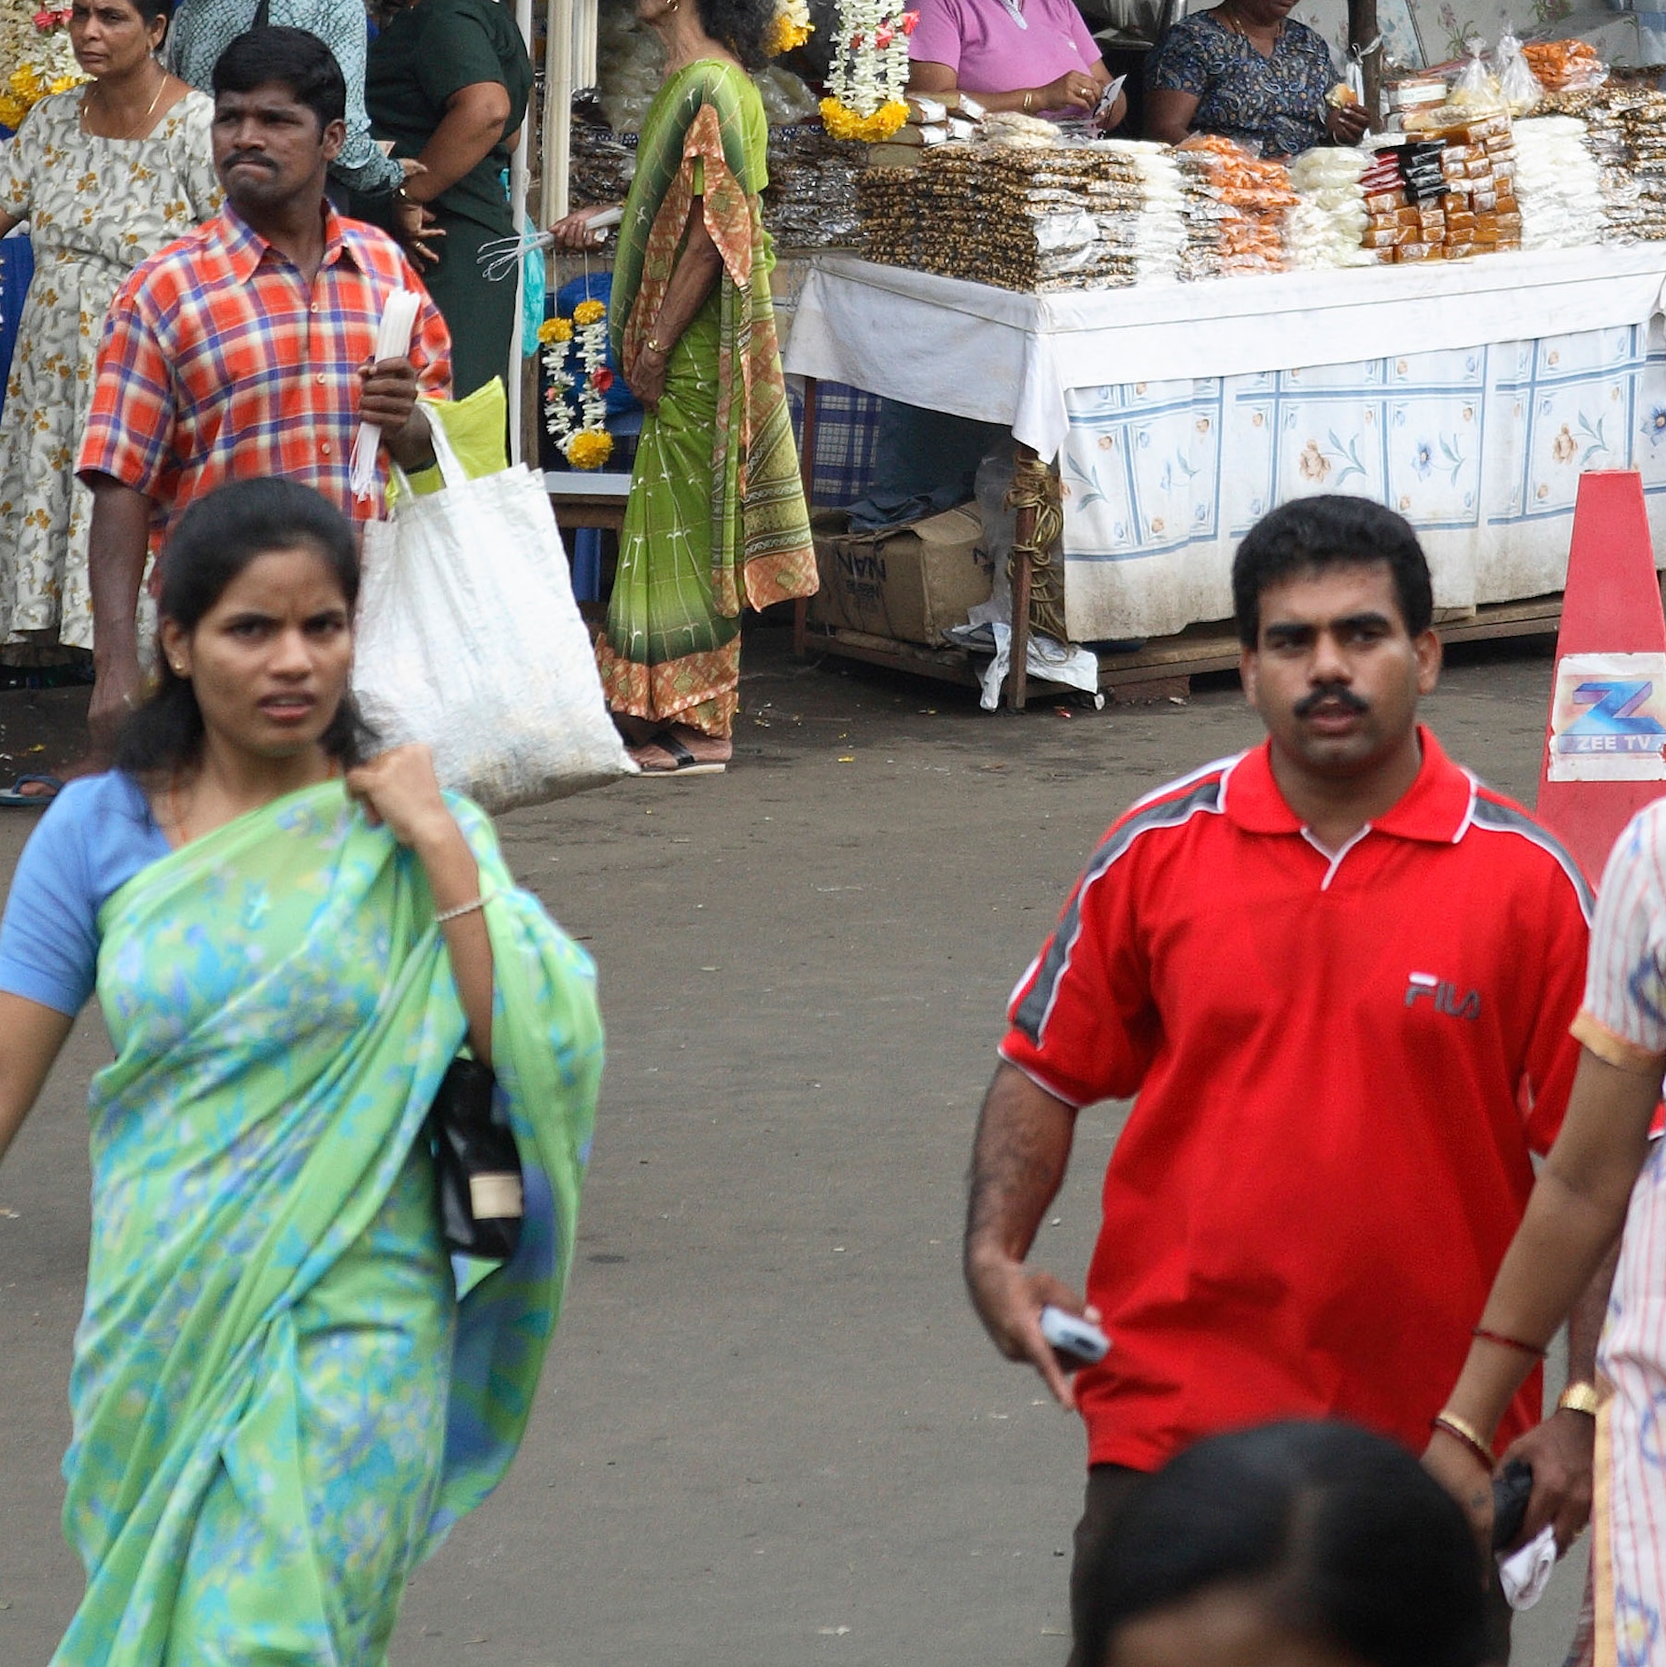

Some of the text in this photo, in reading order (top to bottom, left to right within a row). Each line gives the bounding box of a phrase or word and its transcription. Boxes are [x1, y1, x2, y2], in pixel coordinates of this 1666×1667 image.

[1576, 735, 1652, 751] ZEE TV
[1405, 971, 1480, 1020] FILA
